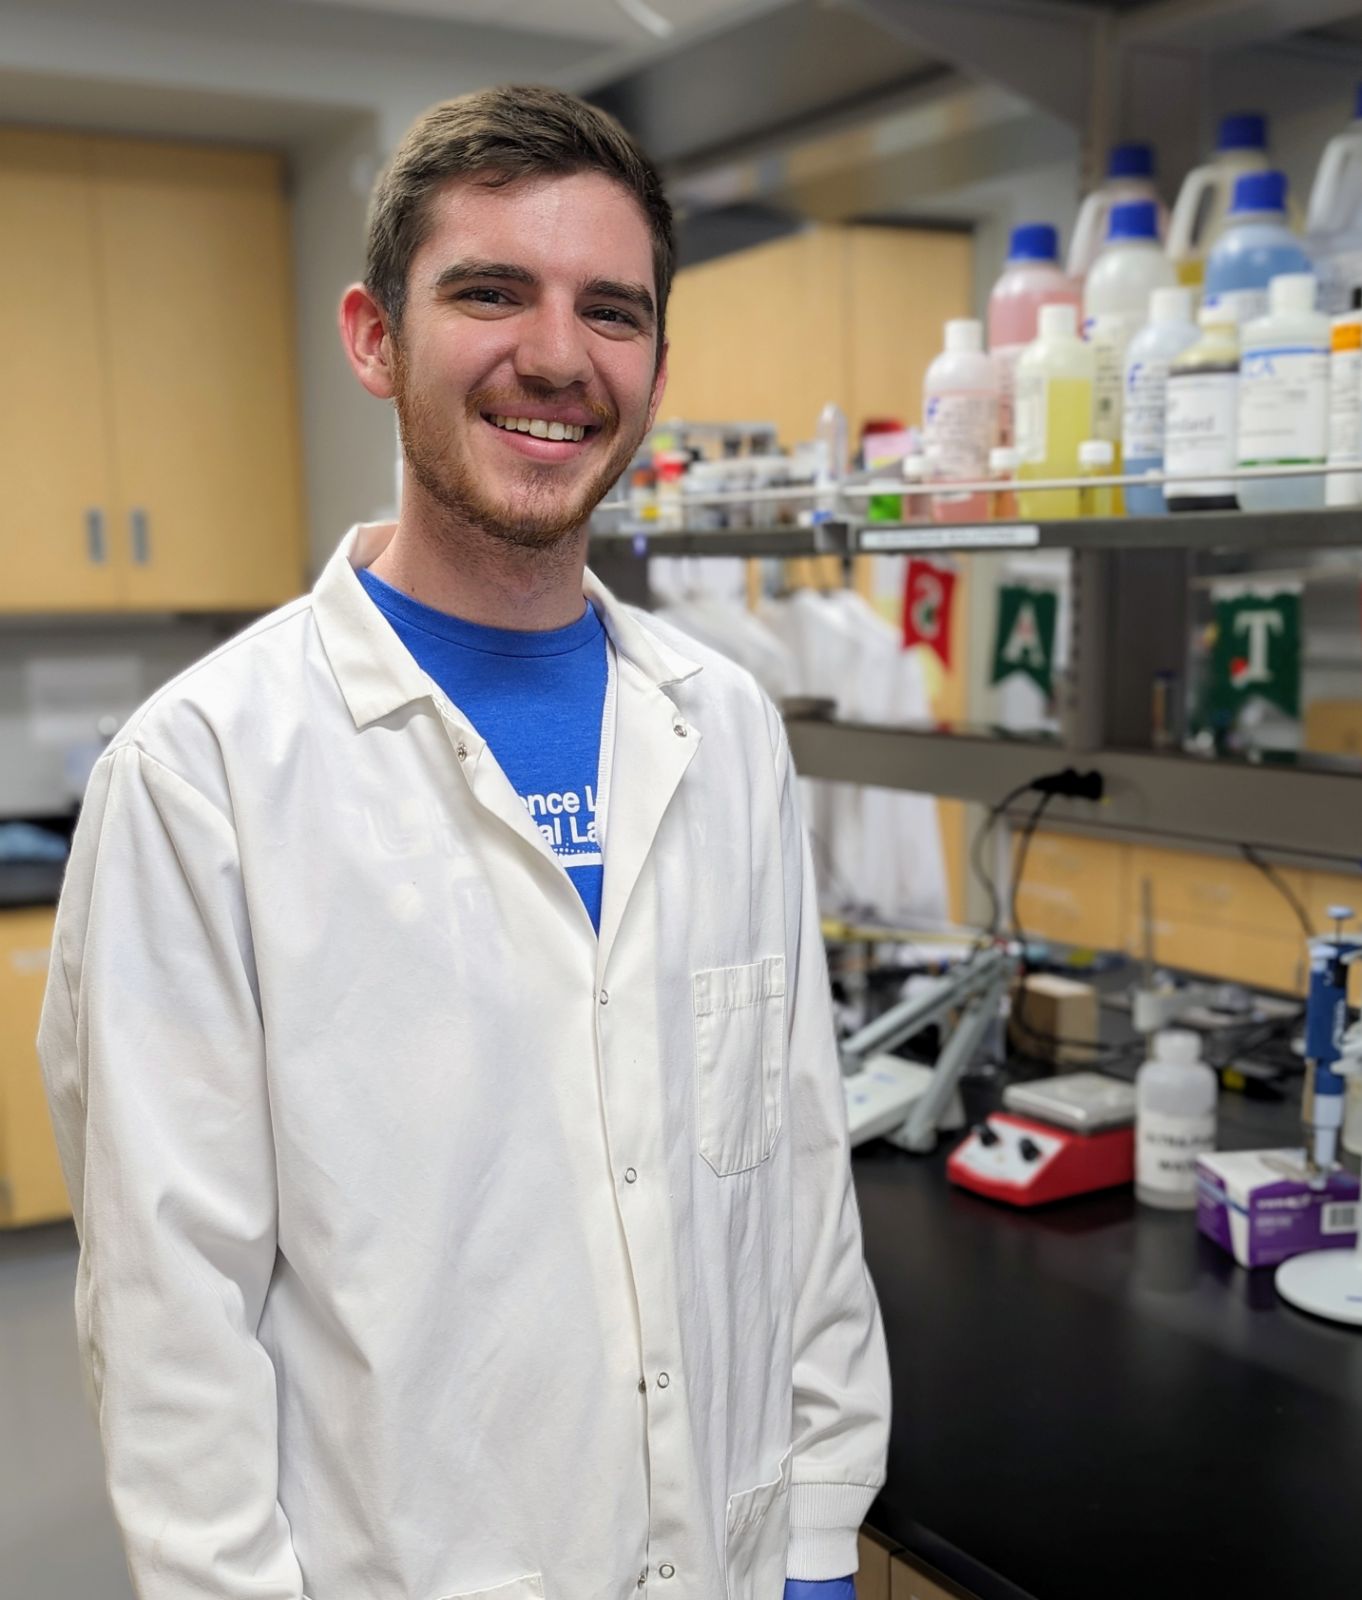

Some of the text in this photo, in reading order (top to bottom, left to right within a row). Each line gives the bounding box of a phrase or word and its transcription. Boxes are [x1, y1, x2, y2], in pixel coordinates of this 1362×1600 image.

[1003, 603, 1045, 667] A
[1233, 608, 1284, 683] T
[519, 792, 580, 815] nce
[535, 817, 562, 845] al
